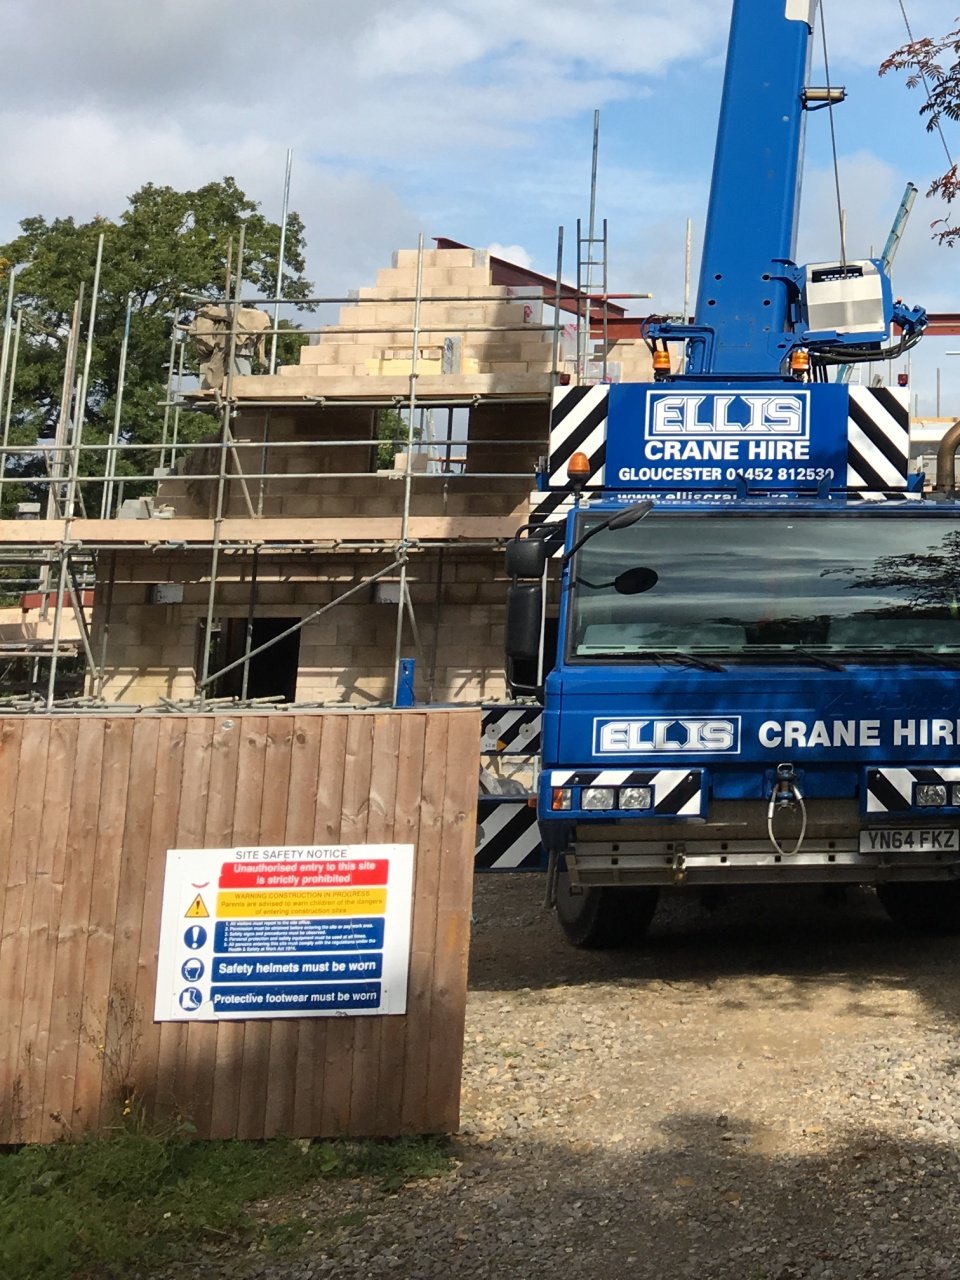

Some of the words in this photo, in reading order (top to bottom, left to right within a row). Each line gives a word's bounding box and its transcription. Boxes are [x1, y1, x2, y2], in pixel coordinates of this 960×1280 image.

[652, 395, 803, 434] ELLIS
[644, 440, 739, 461] CRANE
[749, 440, 810, 460] HIRE
[618, 467, 722, 481] GLOUCESTER
[726, 467, 773, 481] 01452
[600, 721, 734, 751] ELLIS
[758, 720, 880, 749] CRANE
[867, 830, 915, 850] YN64
[919, 830, 955, 849] FKZ
[236, 850, 259, 860] SITE
[262, 850, 304, 859] SAFETY
[306, 849, 348, 858] NOTICE
[234, 862, 297, 873] Unauthorised
[300, 863, 323, 874] entry
[326, 862, 336, 870] to
[338, 861, 355, 870] this
[358, 860, 376, 870] site
[256, 875, 265, 884] is
[267, 874, 300, 886] strictly
[302, 873, 350, 886] prohibited
[263, 908, 289, 916] entering
[219, 963, 253, 976] Safety
[256, 962, 299, 974] helmets
[302, 962, 329, 972] must
[331, 961, 345, 971] be
[348, 961, 376, 971] worn
[214, 993, 263, 1004] Protective
[266, 993, 308, 1003] footwear
[310, 992, 335, 1002] must
[337, 992, 350, 1001] be
[352, 992, 376, 1000] worn
